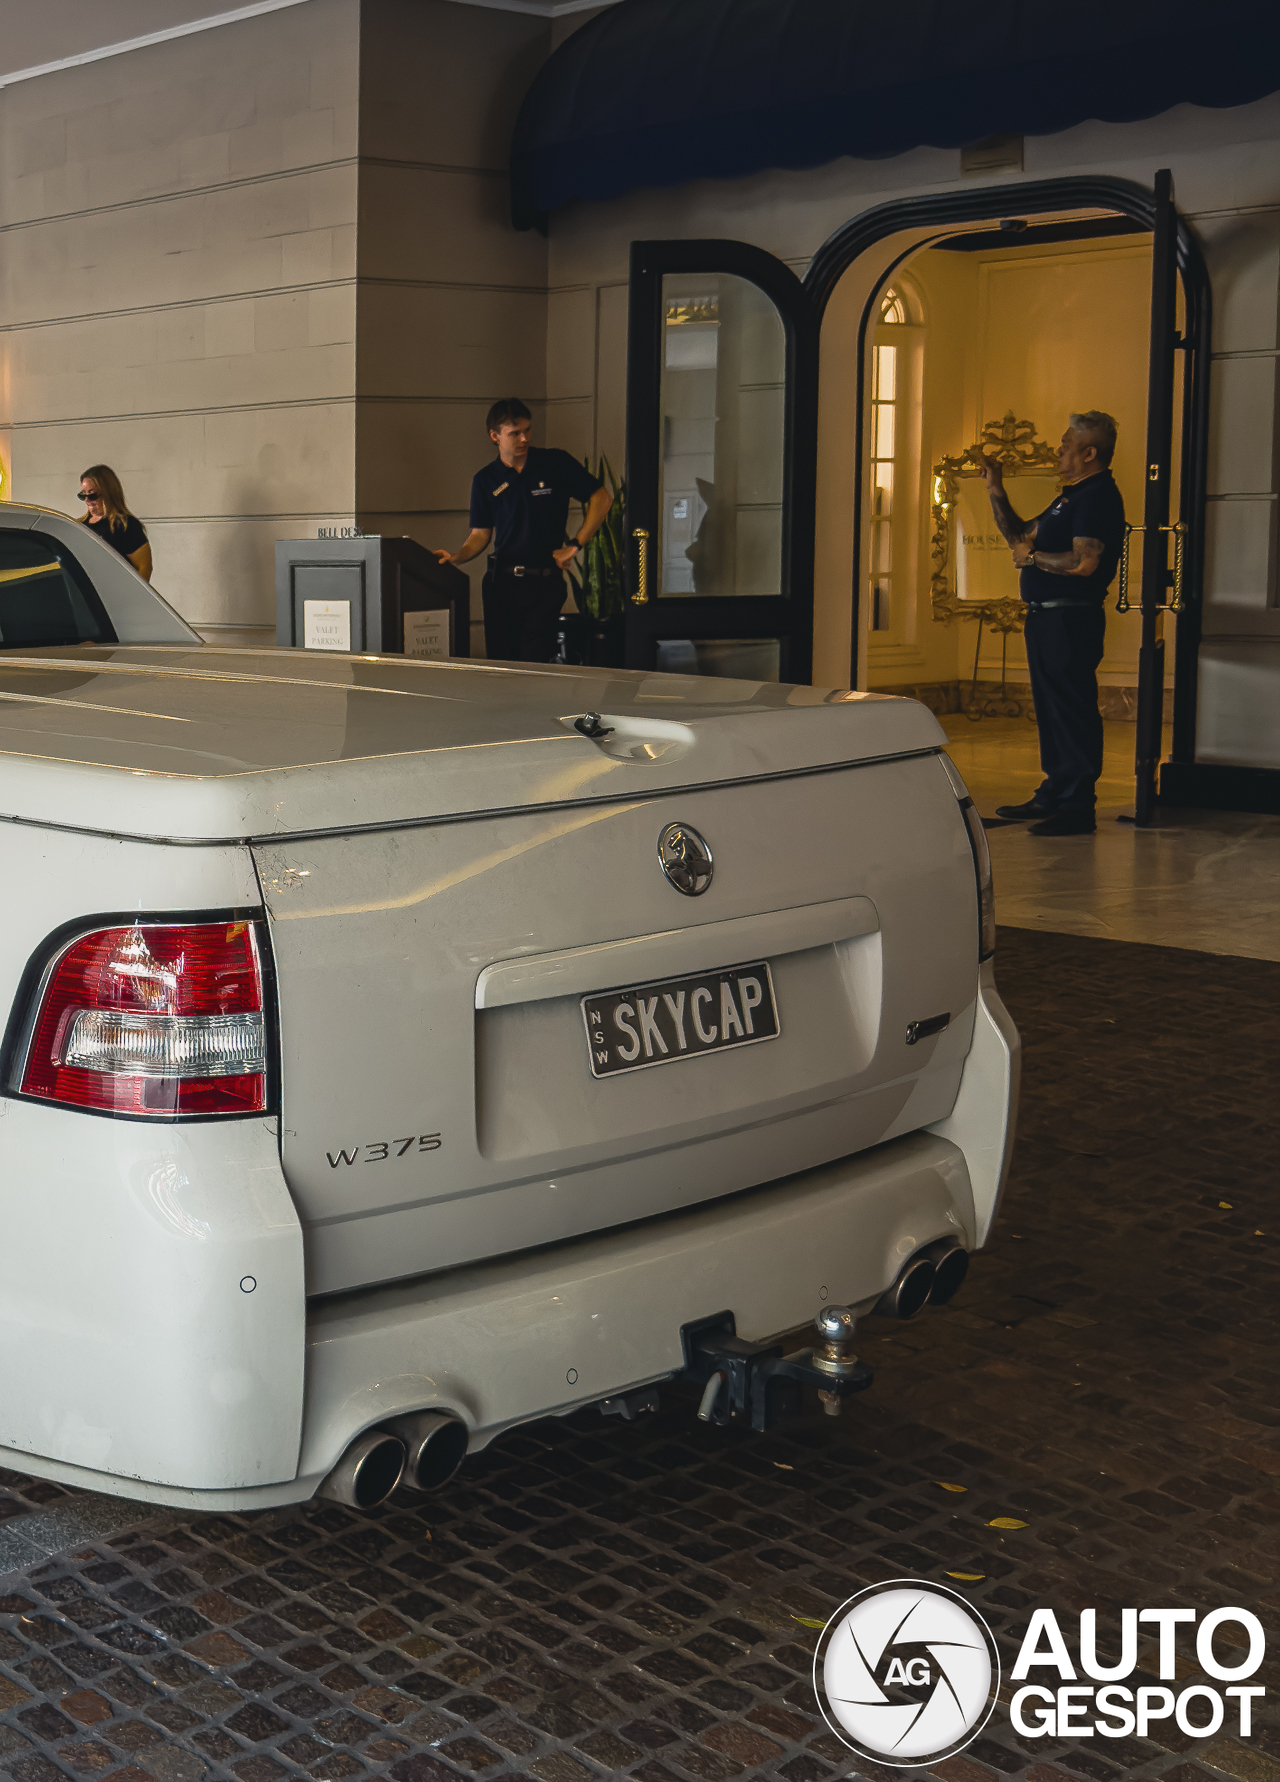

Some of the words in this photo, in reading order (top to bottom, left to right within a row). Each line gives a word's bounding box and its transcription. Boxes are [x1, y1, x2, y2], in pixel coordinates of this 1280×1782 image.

[311, 637, 344, 646] PARKING
[315, 626, 339, 635] VALET
[613, 976, 763, 1062] SKYCAP
[589, 1010, 609, 1065] NSW
